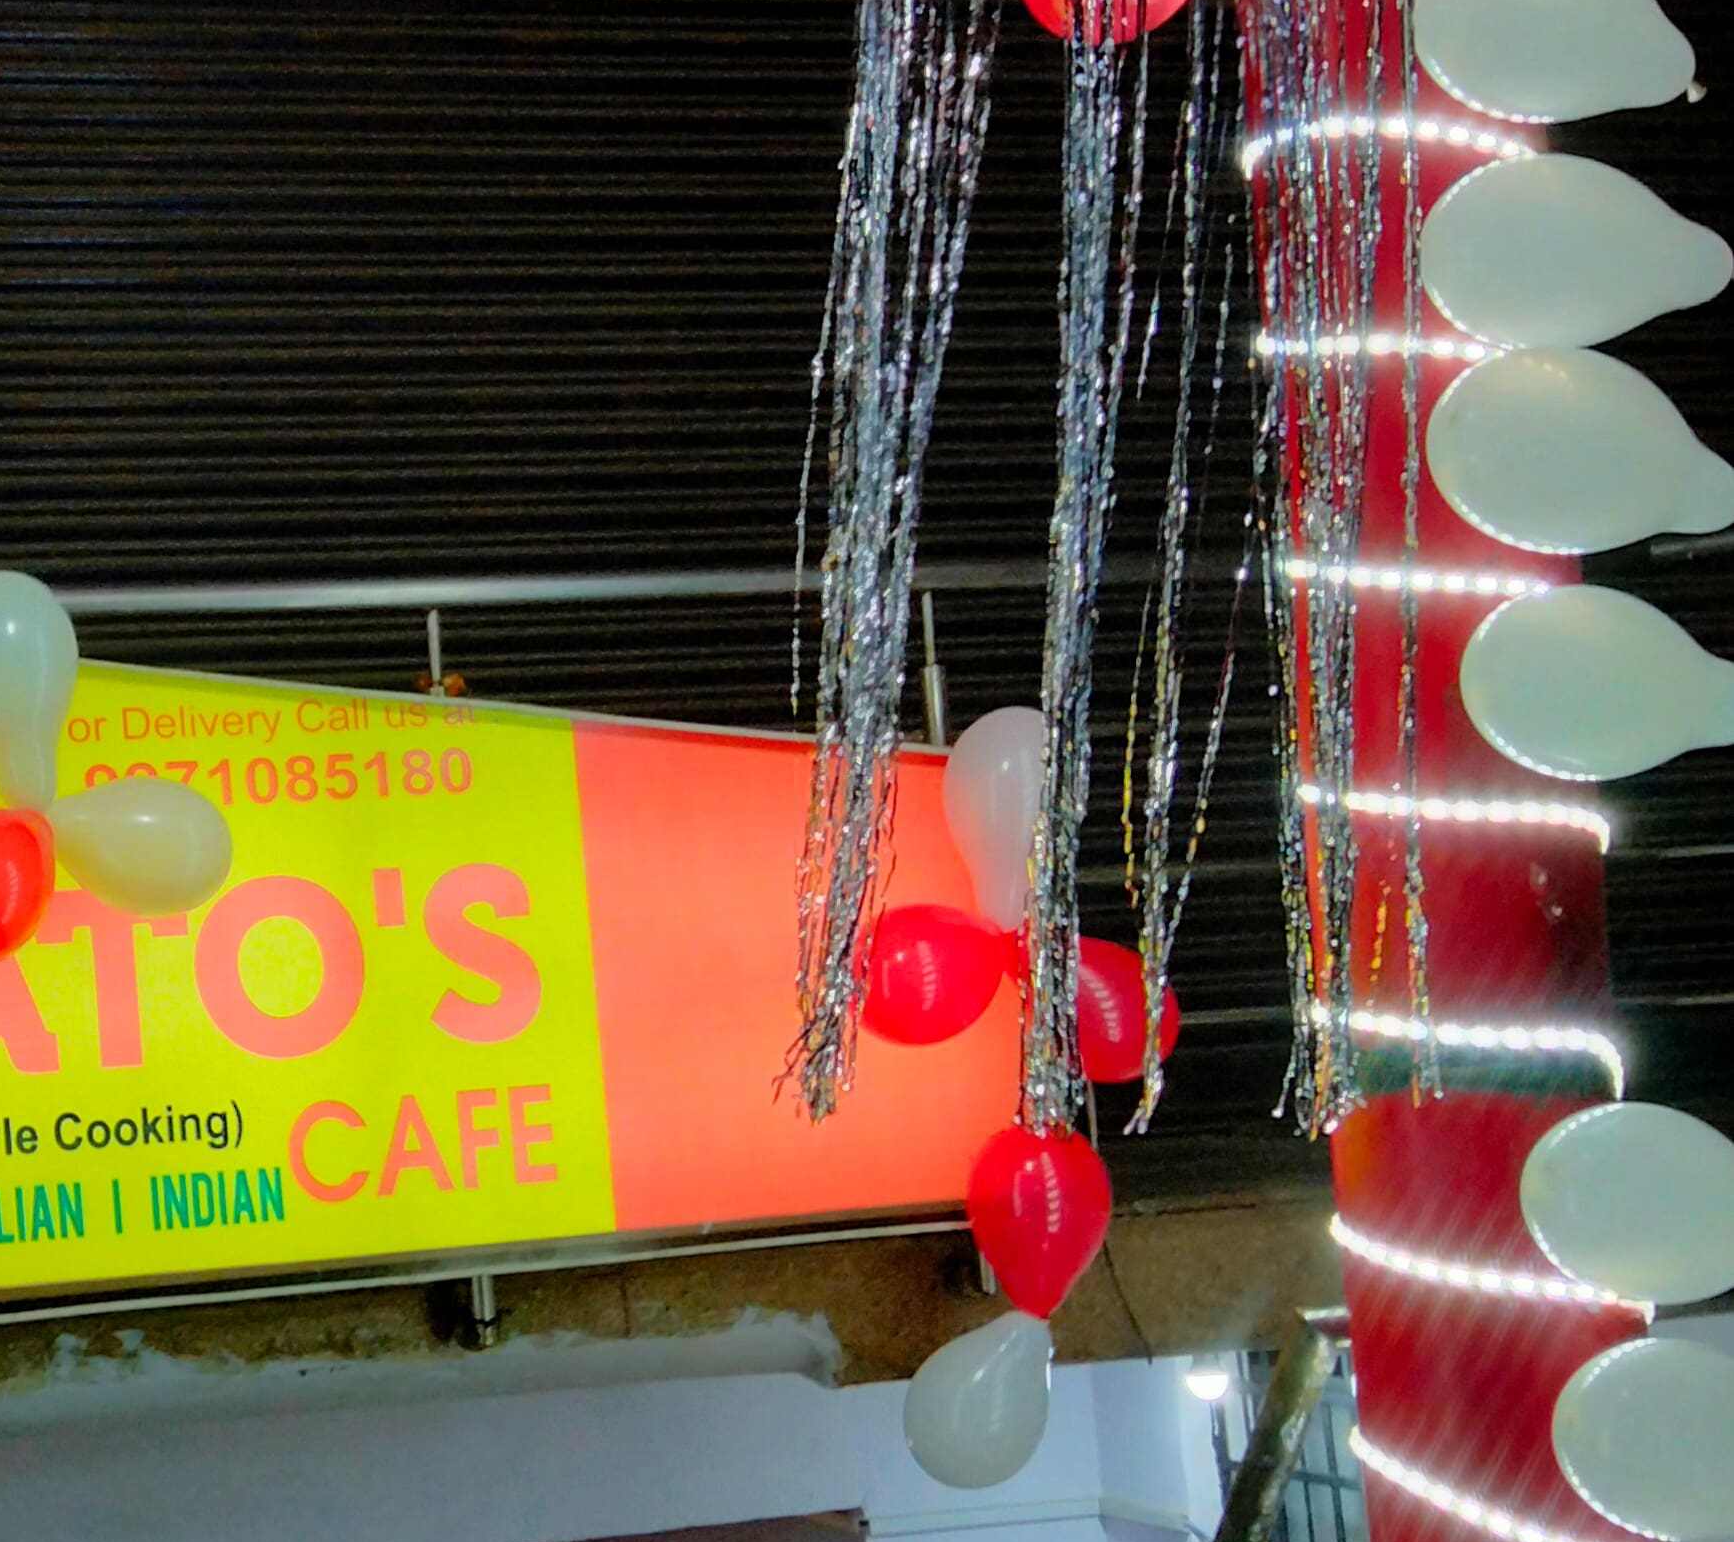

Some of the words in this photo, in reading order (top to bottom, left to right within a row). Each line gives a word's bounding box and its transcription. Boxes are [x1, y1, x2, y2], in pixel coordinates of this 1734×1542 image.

[67, 715, 107, 743] or
[122, 705, 281, 743] Delivery
[296, 699, 368, 733] Call
[384, 702, 428, 729] us
[53, 1101, 244, 1151] Cooking)
[288, 1083, 558, 1203] CAFE
[151, 1167, 285, 1231] INDIAN
